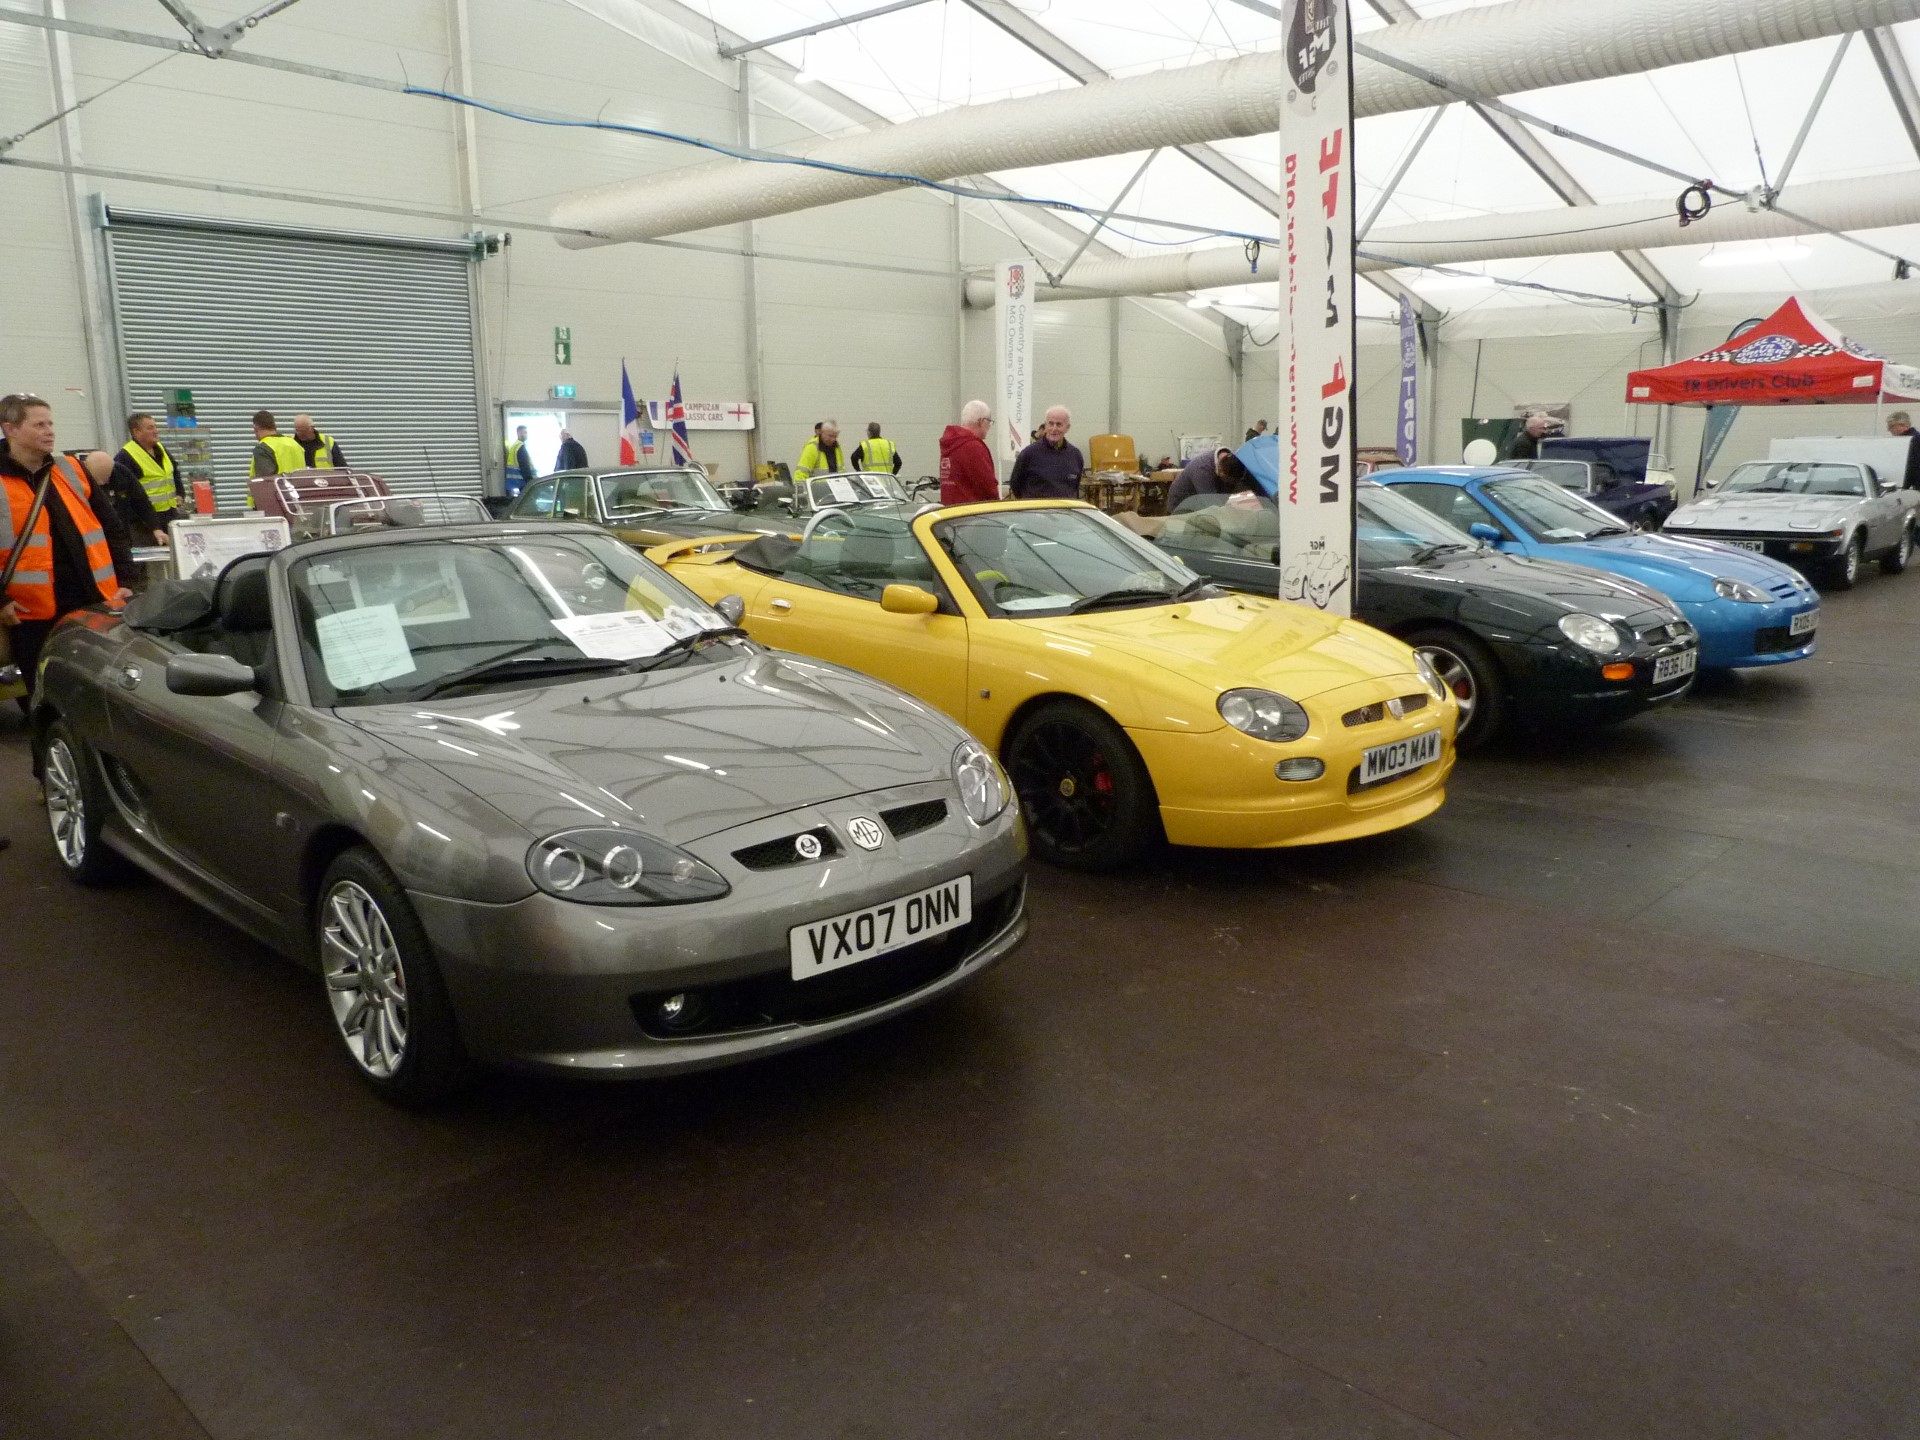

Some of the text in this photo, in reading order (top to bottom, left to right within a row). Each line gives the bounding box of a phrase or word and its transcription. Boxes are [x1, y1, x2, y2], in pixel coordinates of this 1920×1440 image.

[1008, 305, 1016, 324] MG
[1016, 304, 1026, 424] Coventry and Warwick
[1007, 375, 1015, 399] Club
[1683, 373, 1815, 392] TR Drivers Club
[685, 403, 720, 411] CAMPUZAN
[685, 413, 724, 421] LASSIC CARS
[1368, 734, 1436, 777] MW03 MAW
[853, 820, 880, 847] MG
[808, 884, 960, 965] VX07 ONN
